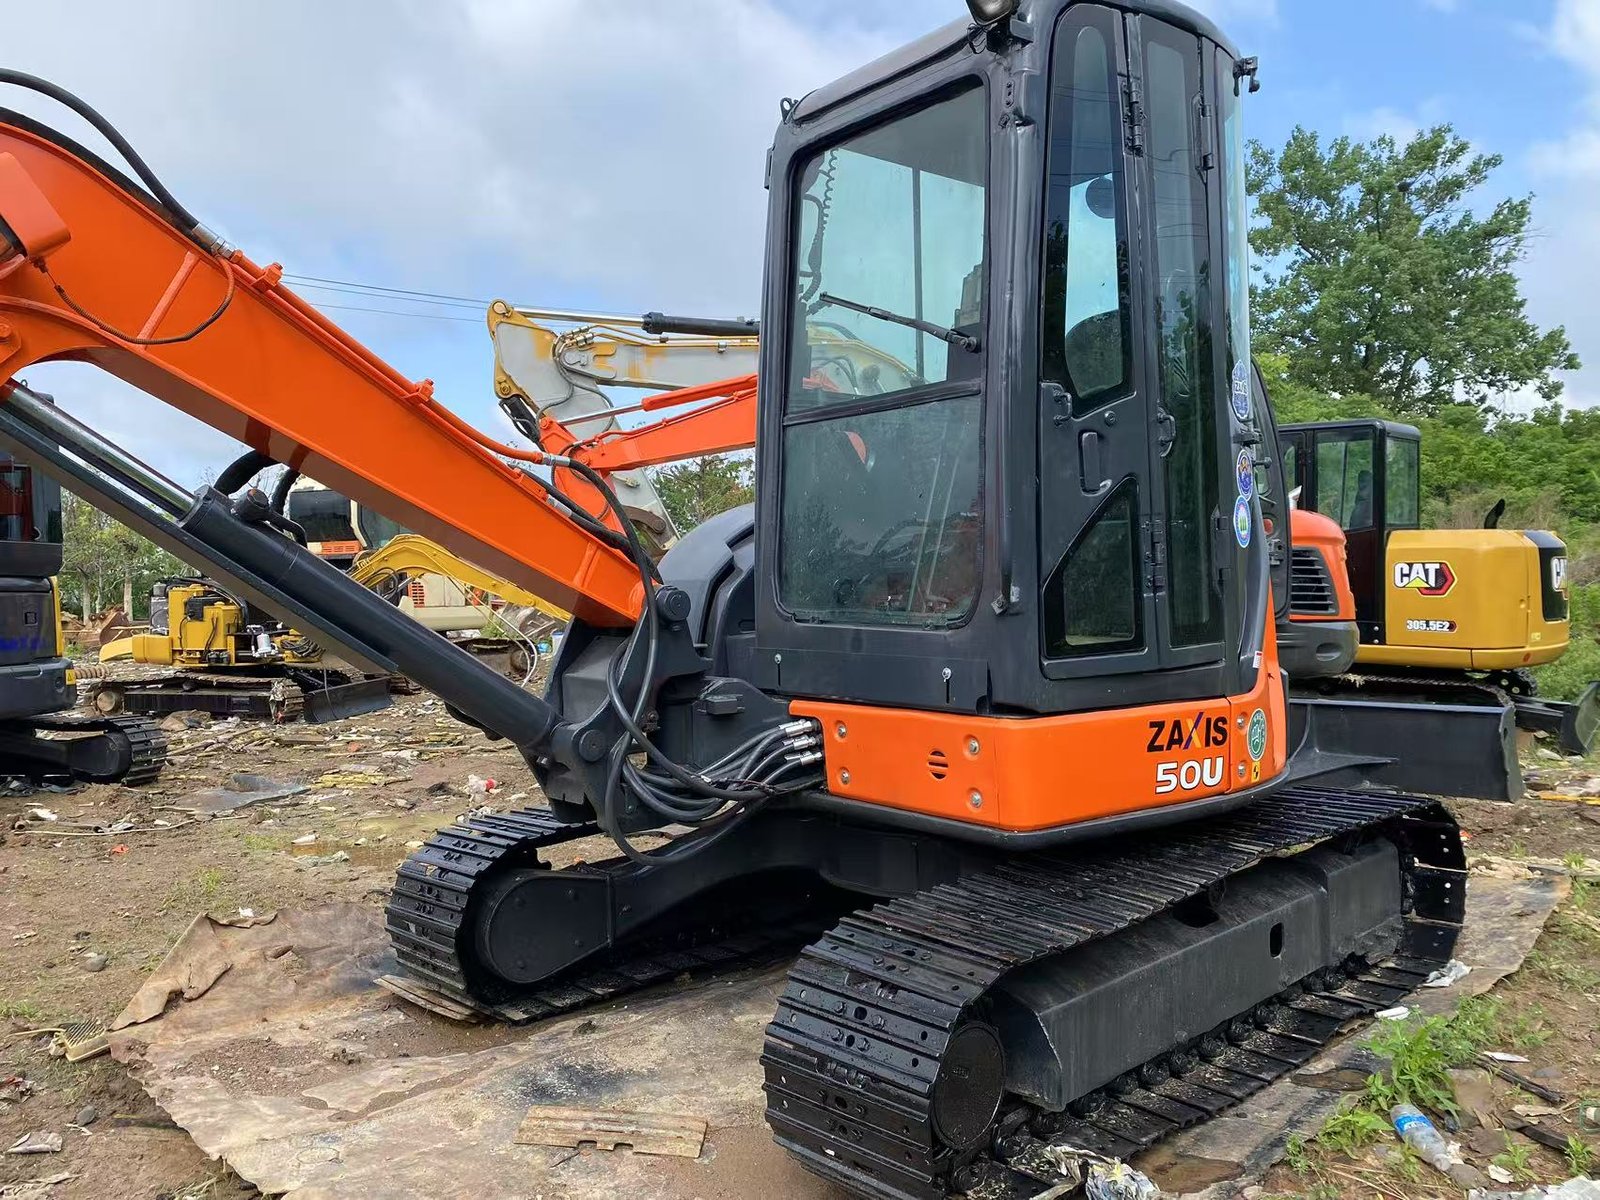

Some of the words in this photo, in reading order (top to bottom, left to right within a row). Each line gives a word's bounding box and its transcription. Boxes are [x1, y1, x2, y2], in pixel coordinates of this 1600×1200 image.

[1394, 562, 1440, 588] CAT
[1406, 619, 1450, 632] 305.5E2
[1147, 711, 1228, 752] ZAXIS
[1155, 756, 1224, 794] 50U
